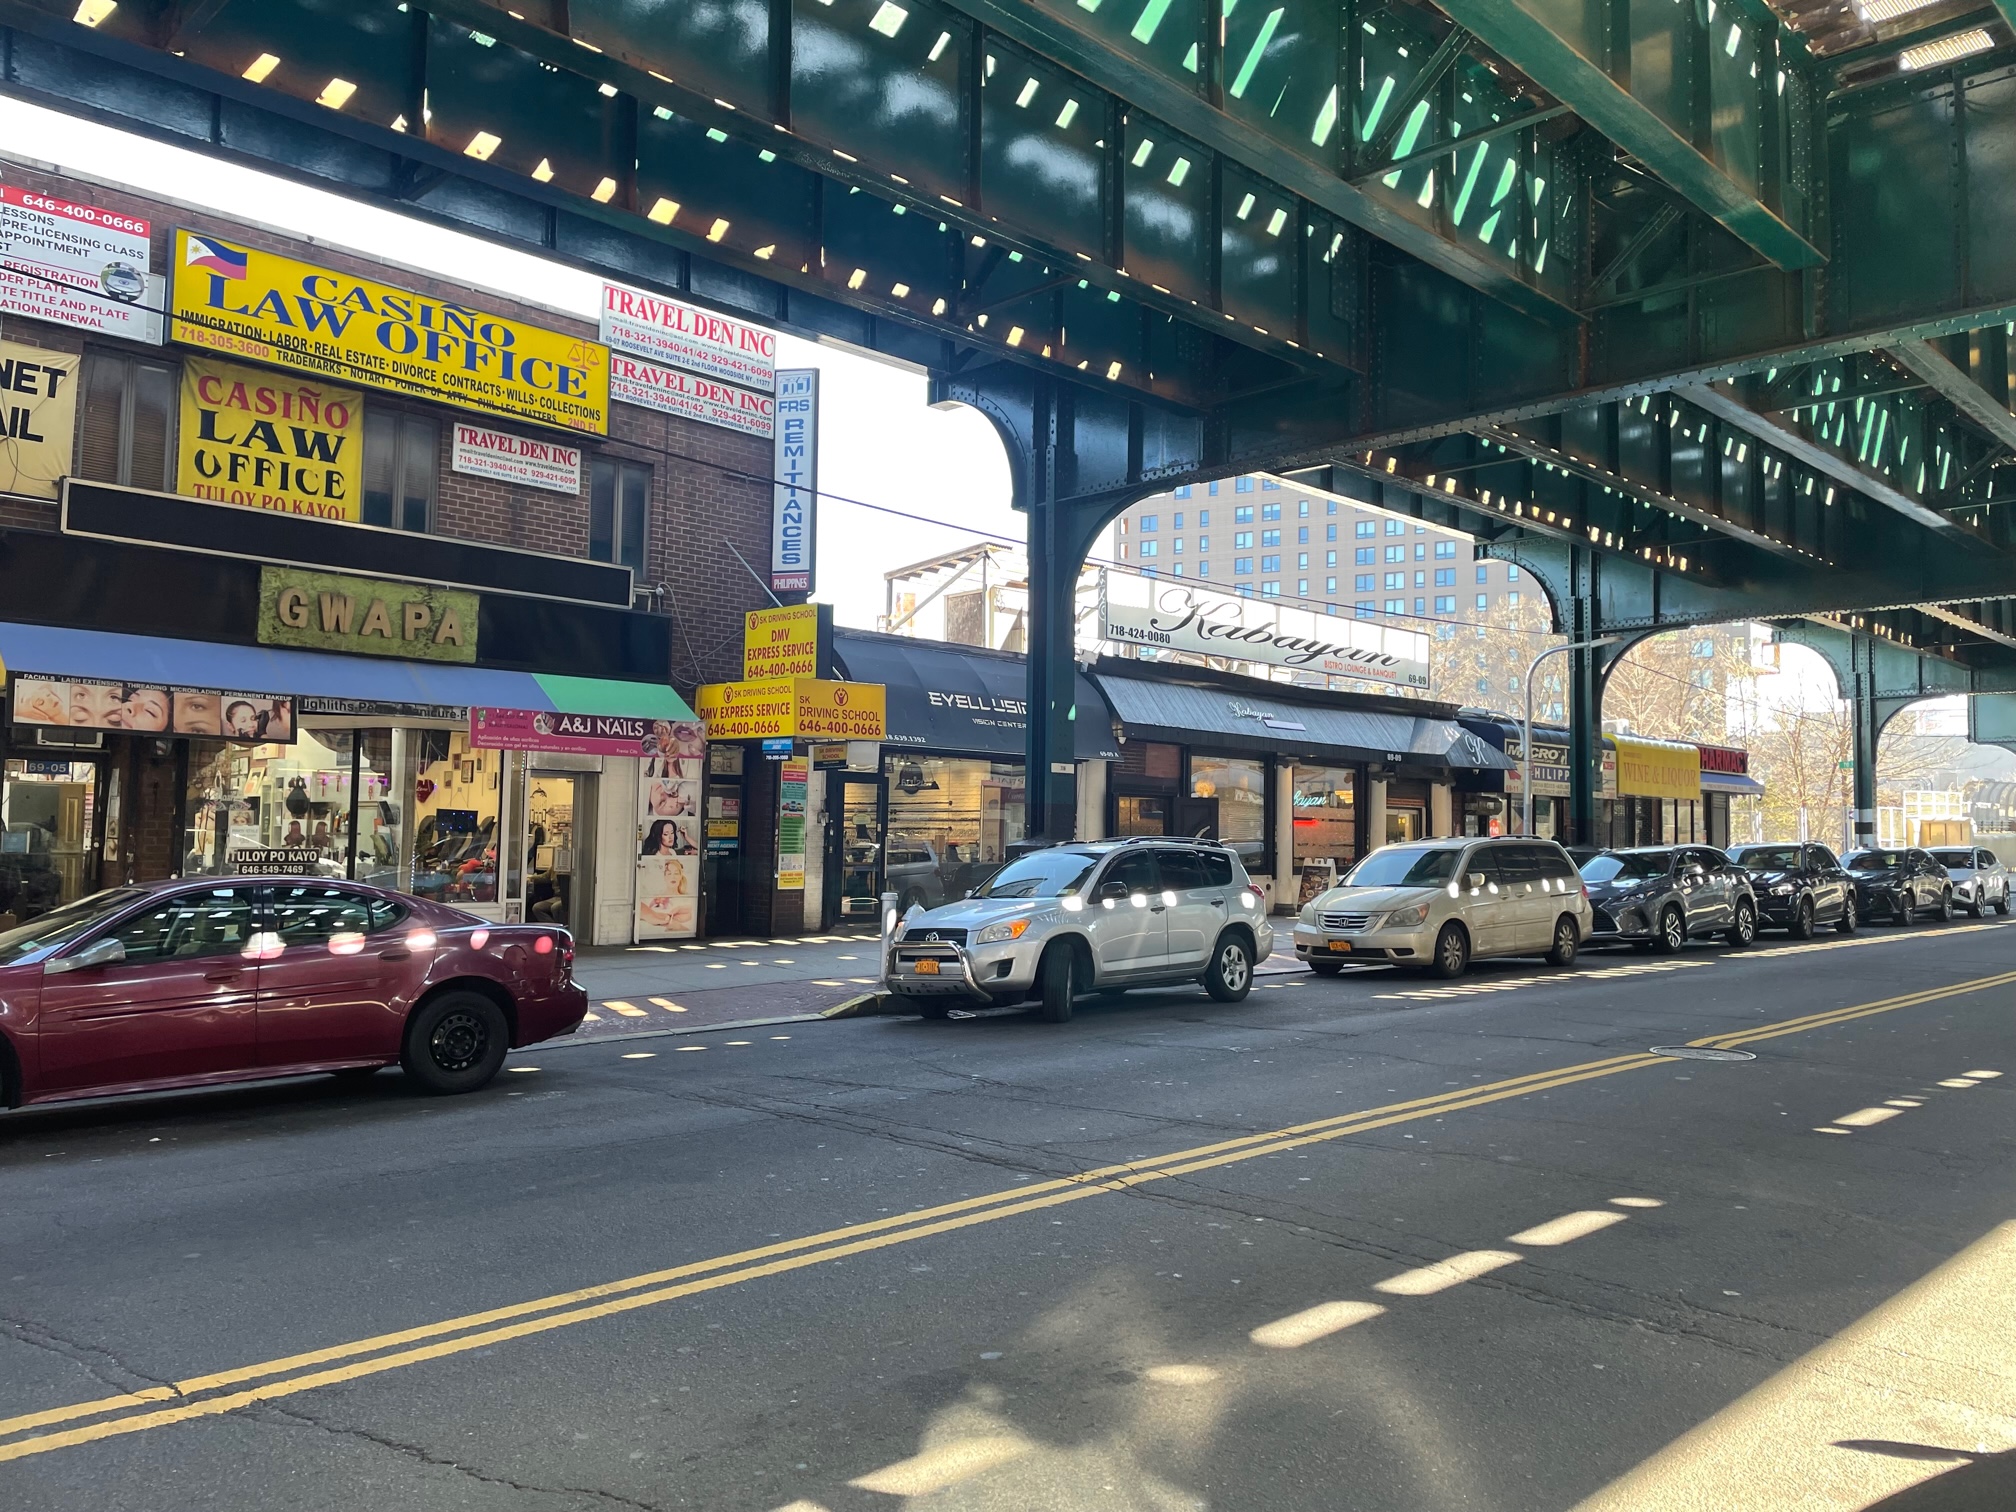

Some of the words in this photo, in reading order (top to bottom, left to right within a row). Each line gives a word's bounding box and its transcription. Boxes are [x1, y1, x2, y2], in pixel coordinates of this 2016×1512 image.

[22, 194, 144, 234] 646-400-0666
[0, 230, 90, 258] APPOINTMENT
[104, 243, 144, 260] CLASS
[3, 260, 98, 289] REGISTRATION
[27, 278, 68, 295] PLATE
[20, 289, 57, 304] TITLE
[60, 299, 86, 312] AND
[90, 305, 129, 321] PLATE
[301, 275, 516, 348] CASIÑO
[44, 308, 104, 328] RENEWAL
[604, 286, 690, 333] TRAVEL
[693, 313, 736, 347] DEN
[739, 327, 774, 358] INC
[205, 272, 357, 339] LAW
[376, 321, 587, 400] OFFICE
[611, 326, 708, 361] 718-321-3940/41/42
[711, 353, 773, 379] 929-421-6099
[621, 339, 653, 355] ROOSEVELT
[654, 349, 665, 359] AVE
[665, 352, 681, 363] SUITE
[701, 361, 718, 372] FLOOR
[718, 365, 744, 380] WOODSIDE
[181, 309, 262, 340] IMMIGRATION
[269, 330, 308, 351] LABOR
[315, 342, 342, 360] REAL
[346, 349, 385, 370] ESTATE
[392, 360, 437, 382] DIVORCE
[443, 373, 501, 397] CONTRACTS
[506, 387, 534, 406] WILLS
[540, 396, 601, 422] COLLECTIONS
[180, 326, 270, 358] 718-305-3600
[276, 349, 341, 375] TRADEMARKS
[350, 367, 386, 385] NOTARY
[568, 418, 586, 431] 2ND
[611, 358, 690, 393] TRAVEL
[695, 380, 736, 409] DEN
[739, 392, 773, 416] INC
[198, 375, 350, 429] CASIÑO
[611, 381, 704, 413] 718-321-3940/41/42
[712, 408, 771, 431] 929-421-6099
[778, 399, 810, 413] FRS
[703, 413, 719, 424] FLOOR
[196, 407, 347, 464] LAW
[458, 427, 517, 455] TRAVEL
[519, 440, 549, 462] DEN
[552, 447, 578, 467] INC
[194, 449, 346, 500] OFFICE
[531, 469, 577, 485] 929-421-6099
[781, 418, 804, 565] REMITTANCES
[262, 494, 286, 512] PO
[773, 577, 808, 590] PHILIPPINES
[277, 586, 464, 647] GWAPA
[759, 616, 768, 625] SK
[768, 612, 792, 623] DRIVING
[793, 608, 816, 620] SCHOOL
[771, 628, 790, 643] DMV
[1109, 623, 1171, 644] 718-424-0080
[1150, 588, 1400, 667] Kabayan
[747, 645, 780, 661] EXPRESS
[782, 641, 814, 657] SERVICE
[747, 660, 813, 678] 646-400-0666
[1324, 660, 1344, 671] BISTRO
[1344, 664, 1367, 675] LOUNGE
[1373, 668, 1397, 679] BANQUET
[1408, 673, 1427, 685] 69-09
[23, 673, 55, 682] FACIALS
[82, 678, 123, 688] EXTENSION
[127, 682, 167, 691] THREADING
[170, 686, 221, 696] MICROBLADING
[224, 690, 264, 700] PERMANENT
[734, 690, 742, 698] SK
[743, 687, 766, 697] DRIVING
[767, 685, 792, 695] SCHOOL
[799, 695, 810, 705] SK
[700, 706, 718, 720] DMV
[720, 704, 754, 719] EXPRESS
[756, 702, 790, 717] SERVICE
[799, 706, 839, 719] DRIVING
[842, 709, 880, 722] SCHOOL
[1229, 701, 1274, 721] Kabayan
[558, 716, 591, 734] A&J
[597, 717, 644, 737] NAILS
[707, 720, 780, 737] 646-400-0666
[799, 720, 881, 736] 646-400-0666
[972, 717, 996, 726] VISION
[885, 734, 926, 743] 18.639.1392
[29, 763, 67, 773] 69-05
[1701, 748, 1749, 773] HARMACY
[1624, 762, 1650, 783] WINE
[1652, 766, 1660, 784] &
[1661, 767, 1696, 787] LIQUOR
[229, 849, 267, 863] TULOY
[270, 851, 285, 862] PO
[288, 850, 317, 861] KAYO
[241, 865, 304, 874] 646-549-7469
